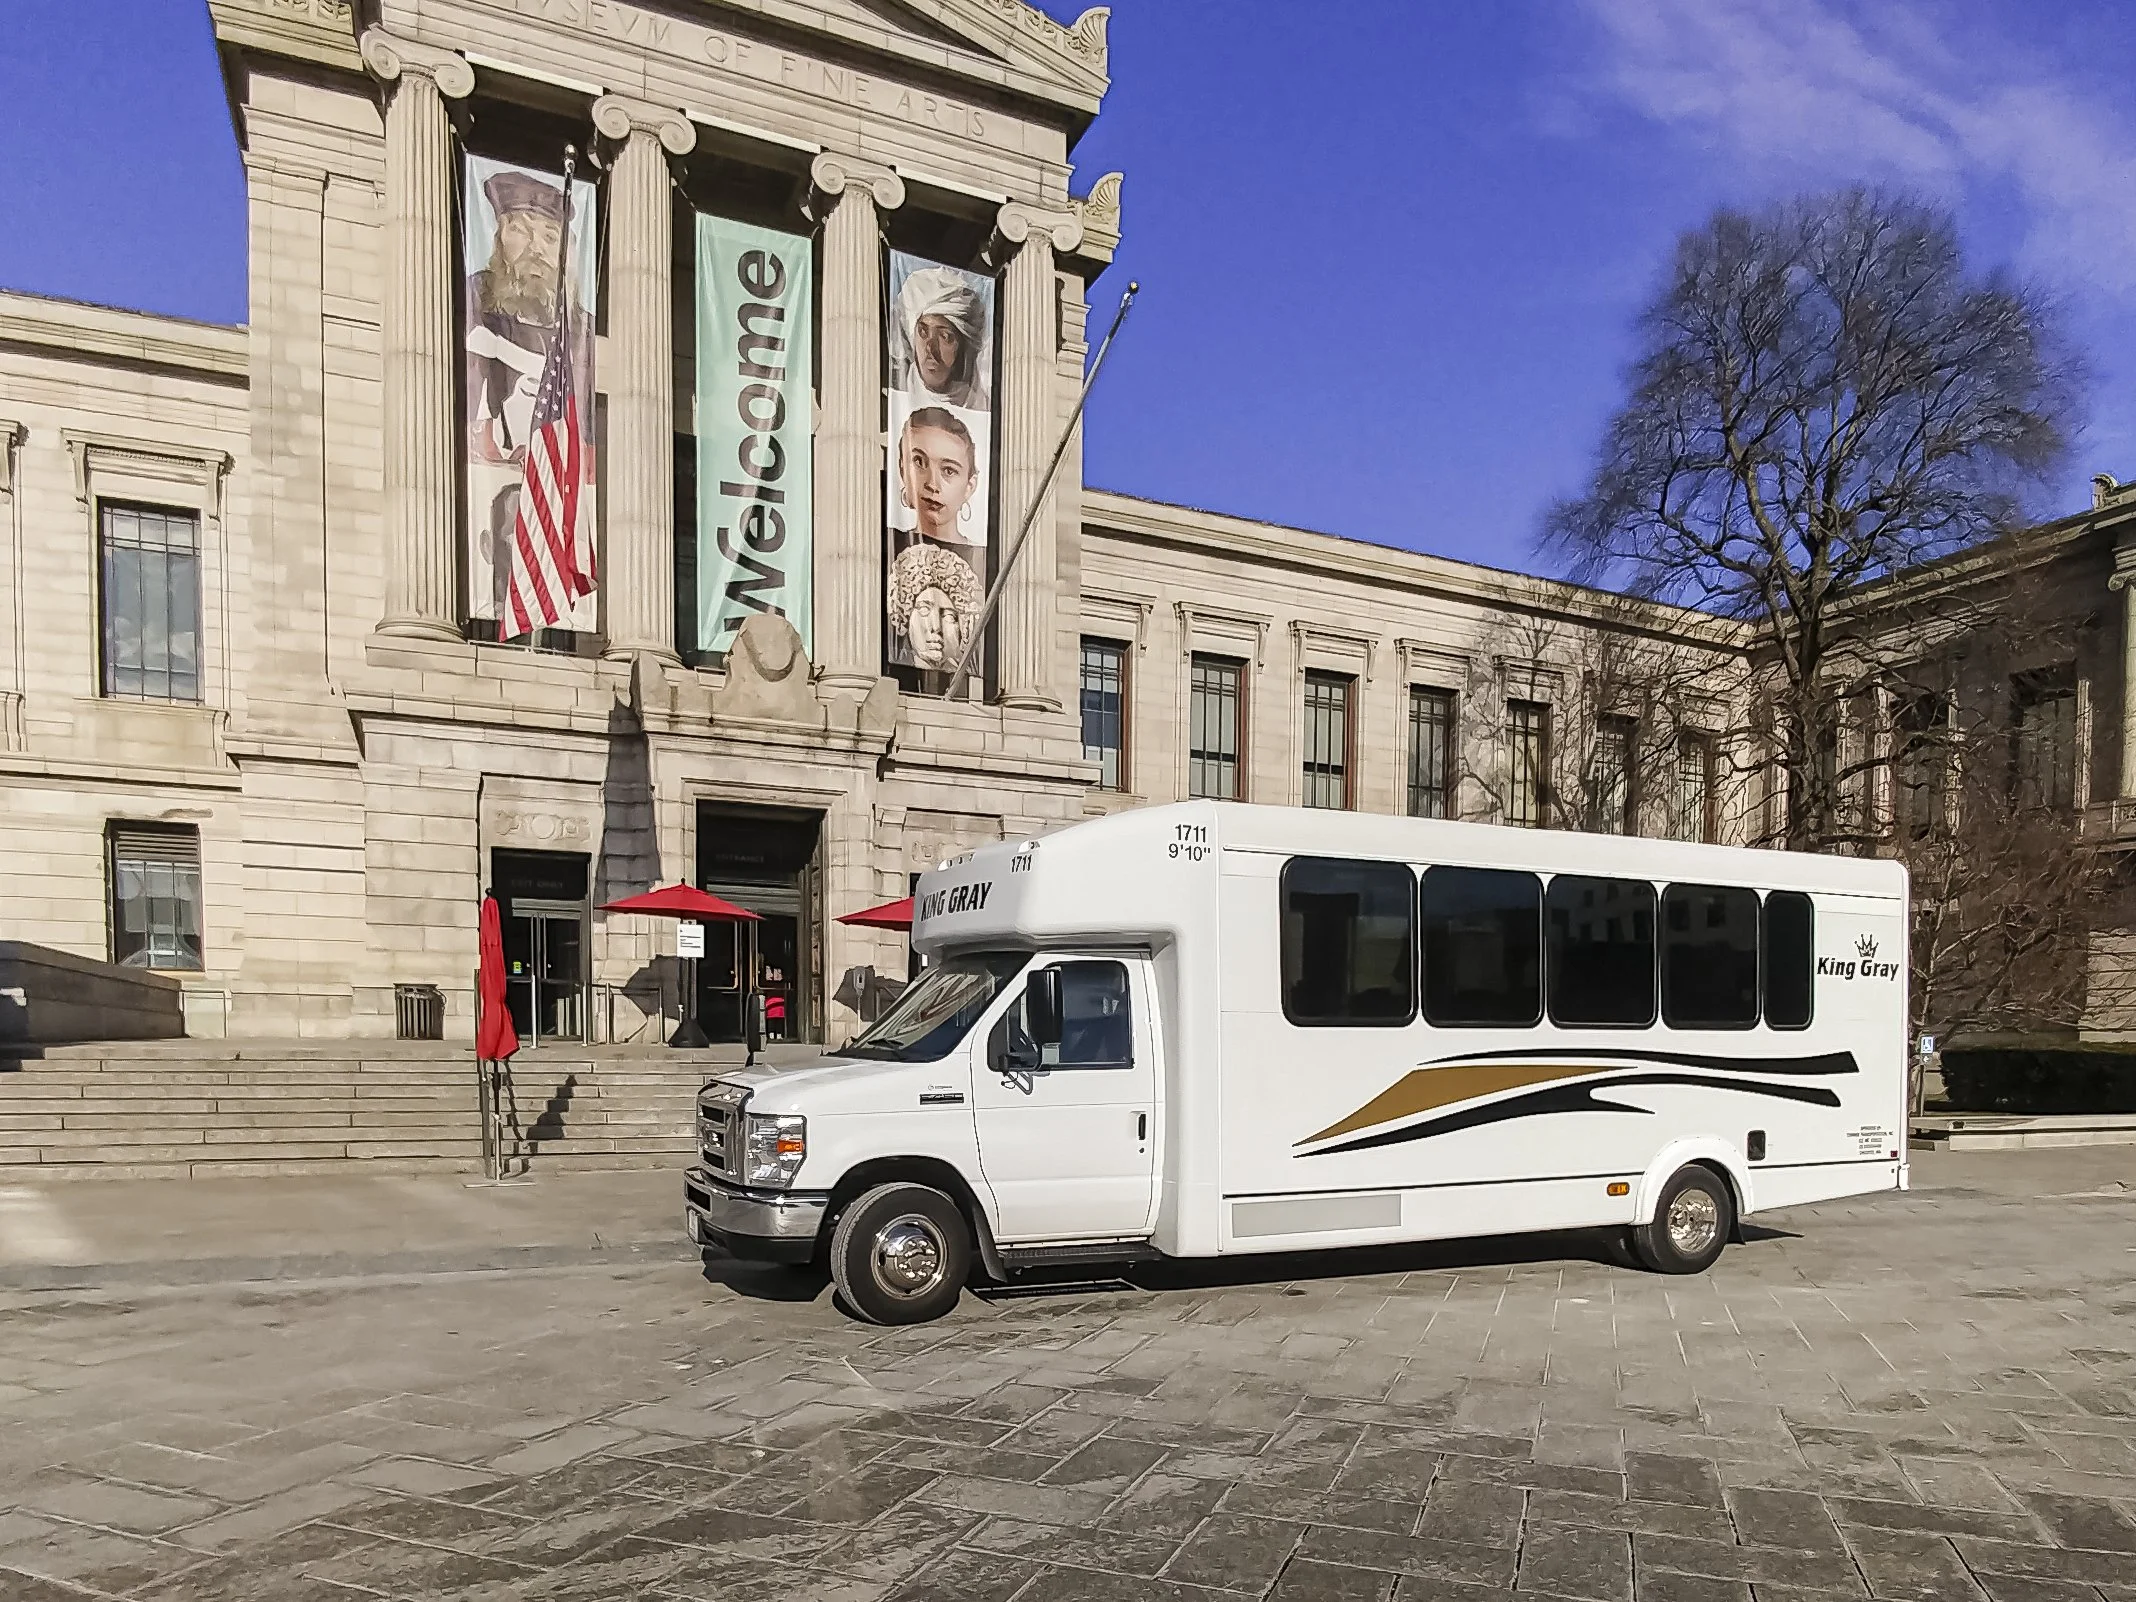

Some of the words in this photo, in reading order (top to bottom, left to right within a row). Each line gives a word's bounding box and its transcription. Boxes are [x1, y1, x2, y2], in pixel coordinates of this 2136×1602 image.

[703, 35, 752, 68] OF
[896, 87, 985, 137] ARTS
[716, 249, 787, 632] Welcome
[1175, 824, 1206, 843] 1711
[1011, 854, 1032, 873] 1711
[1168, 843, 1210, 861] 9'10"
[921, 889, 946, 921] KING
[948, 882, 993, 914] GRAY
[1816, 956, 1856, 980] King
[1860, 959, 1899, 981] Gray
